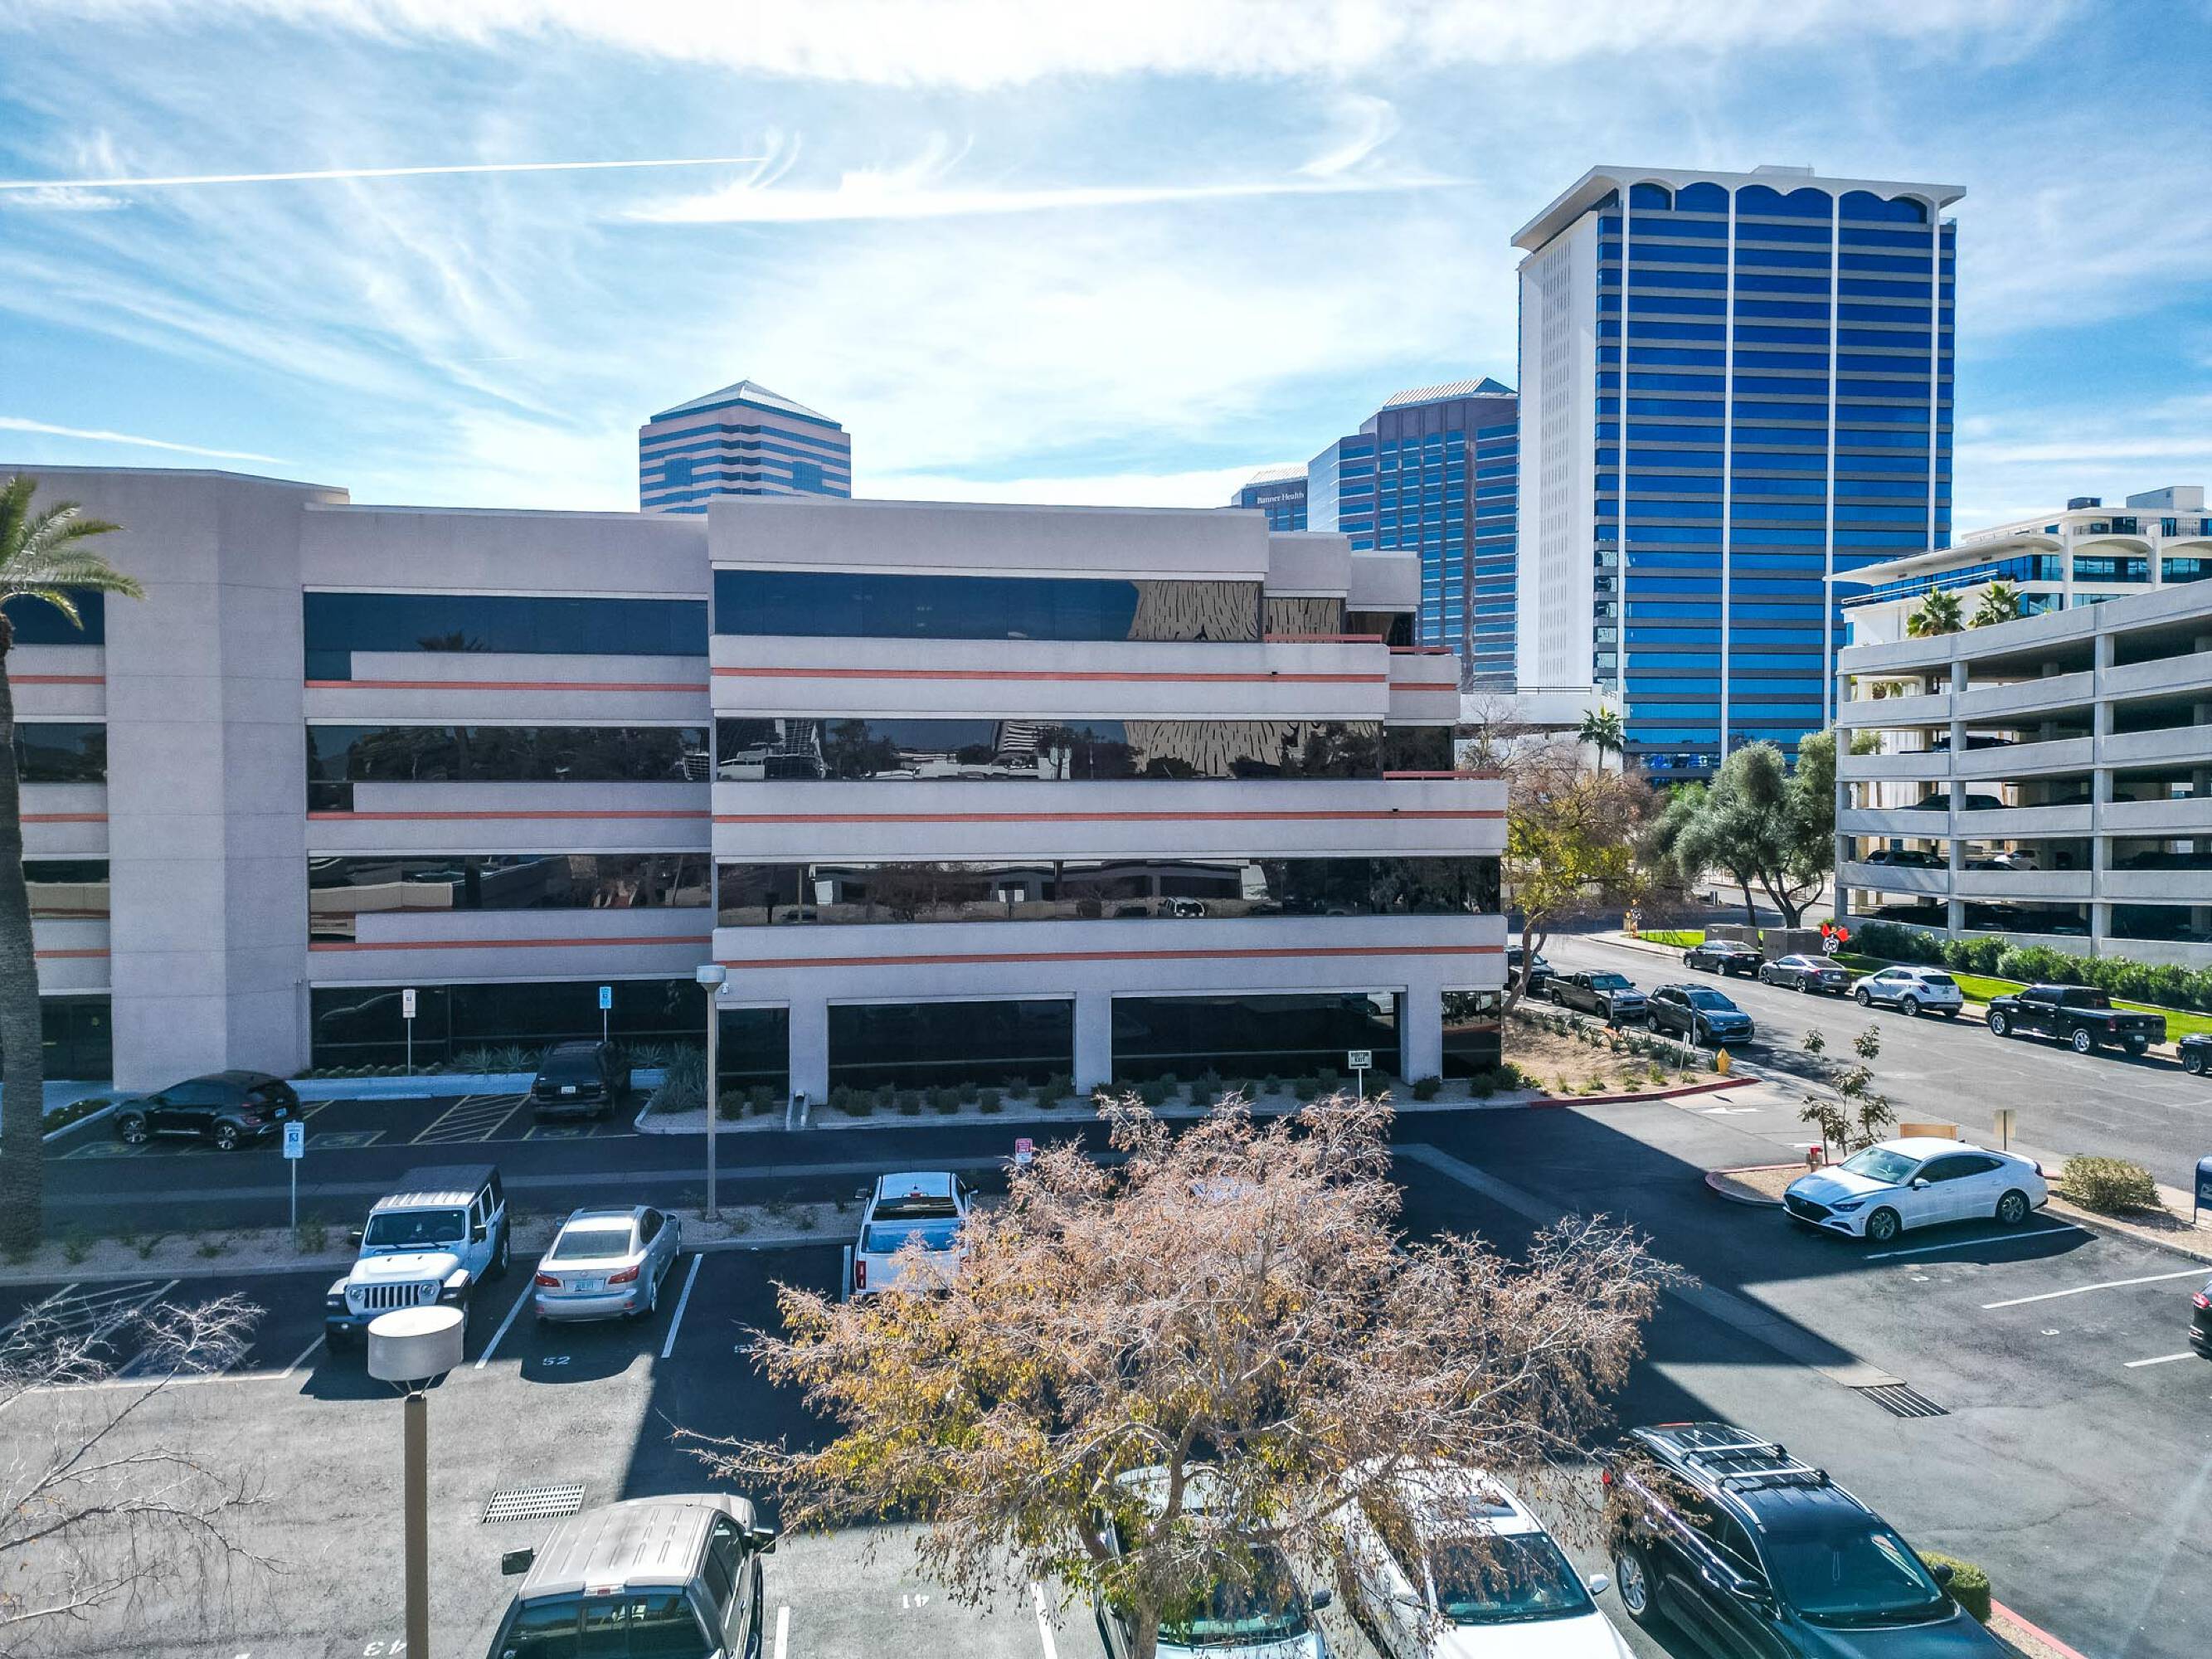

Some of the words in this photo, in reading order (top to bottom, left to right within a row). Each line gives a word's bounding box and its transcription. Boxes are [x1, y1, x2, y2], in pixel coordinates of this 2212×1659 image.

[1257, 496, 1281, 504] Banner
[1281, 491, 1305, 501] Health
[542, 1356, 571, 1365] 52
[902, 1593, 930, 1608] 41
